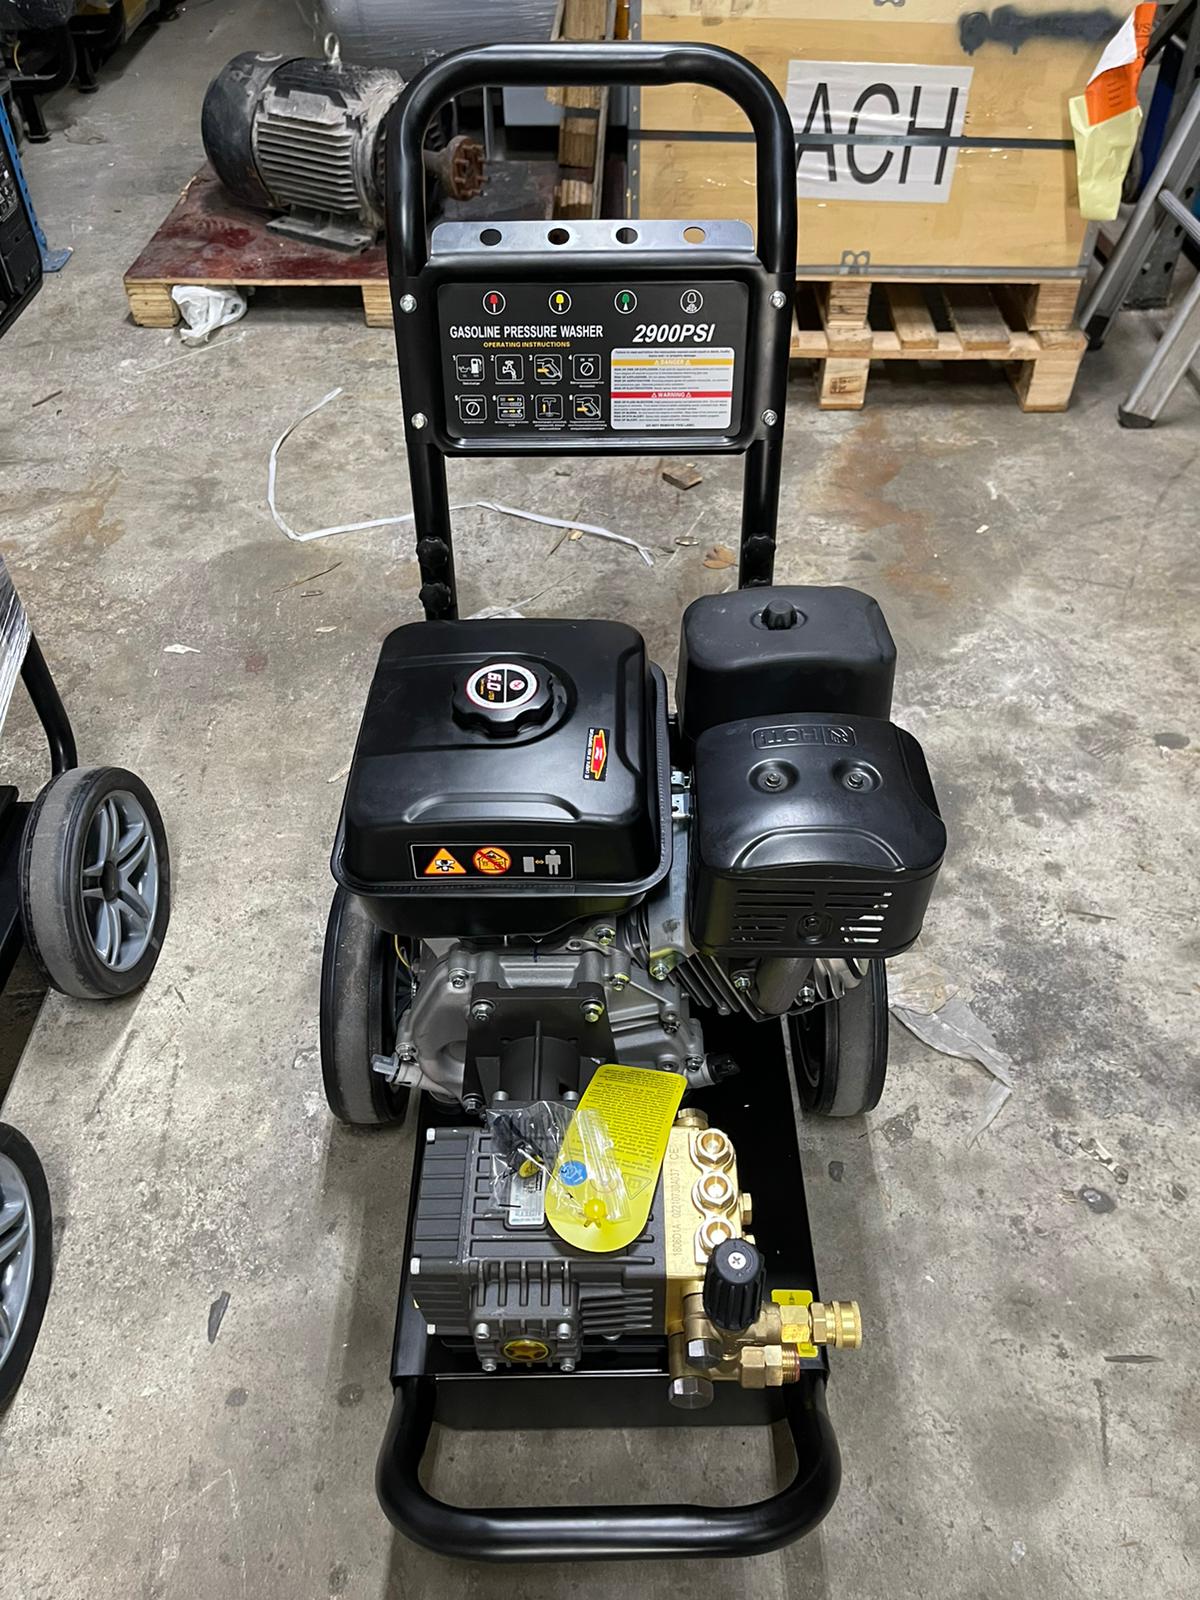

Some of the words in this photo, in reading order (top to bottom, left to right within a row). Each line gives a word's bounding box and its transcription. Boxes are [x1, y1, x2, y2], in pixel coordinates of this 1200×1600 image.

[450, 326, 501, 339] GASOLINE
[504, 326, 557, 338] PRESSURE
[560, 325, 603, 338] WASHER
[632, 323, 716, 343] 2900PSI
[486, 672, 502, 691] 6.0
